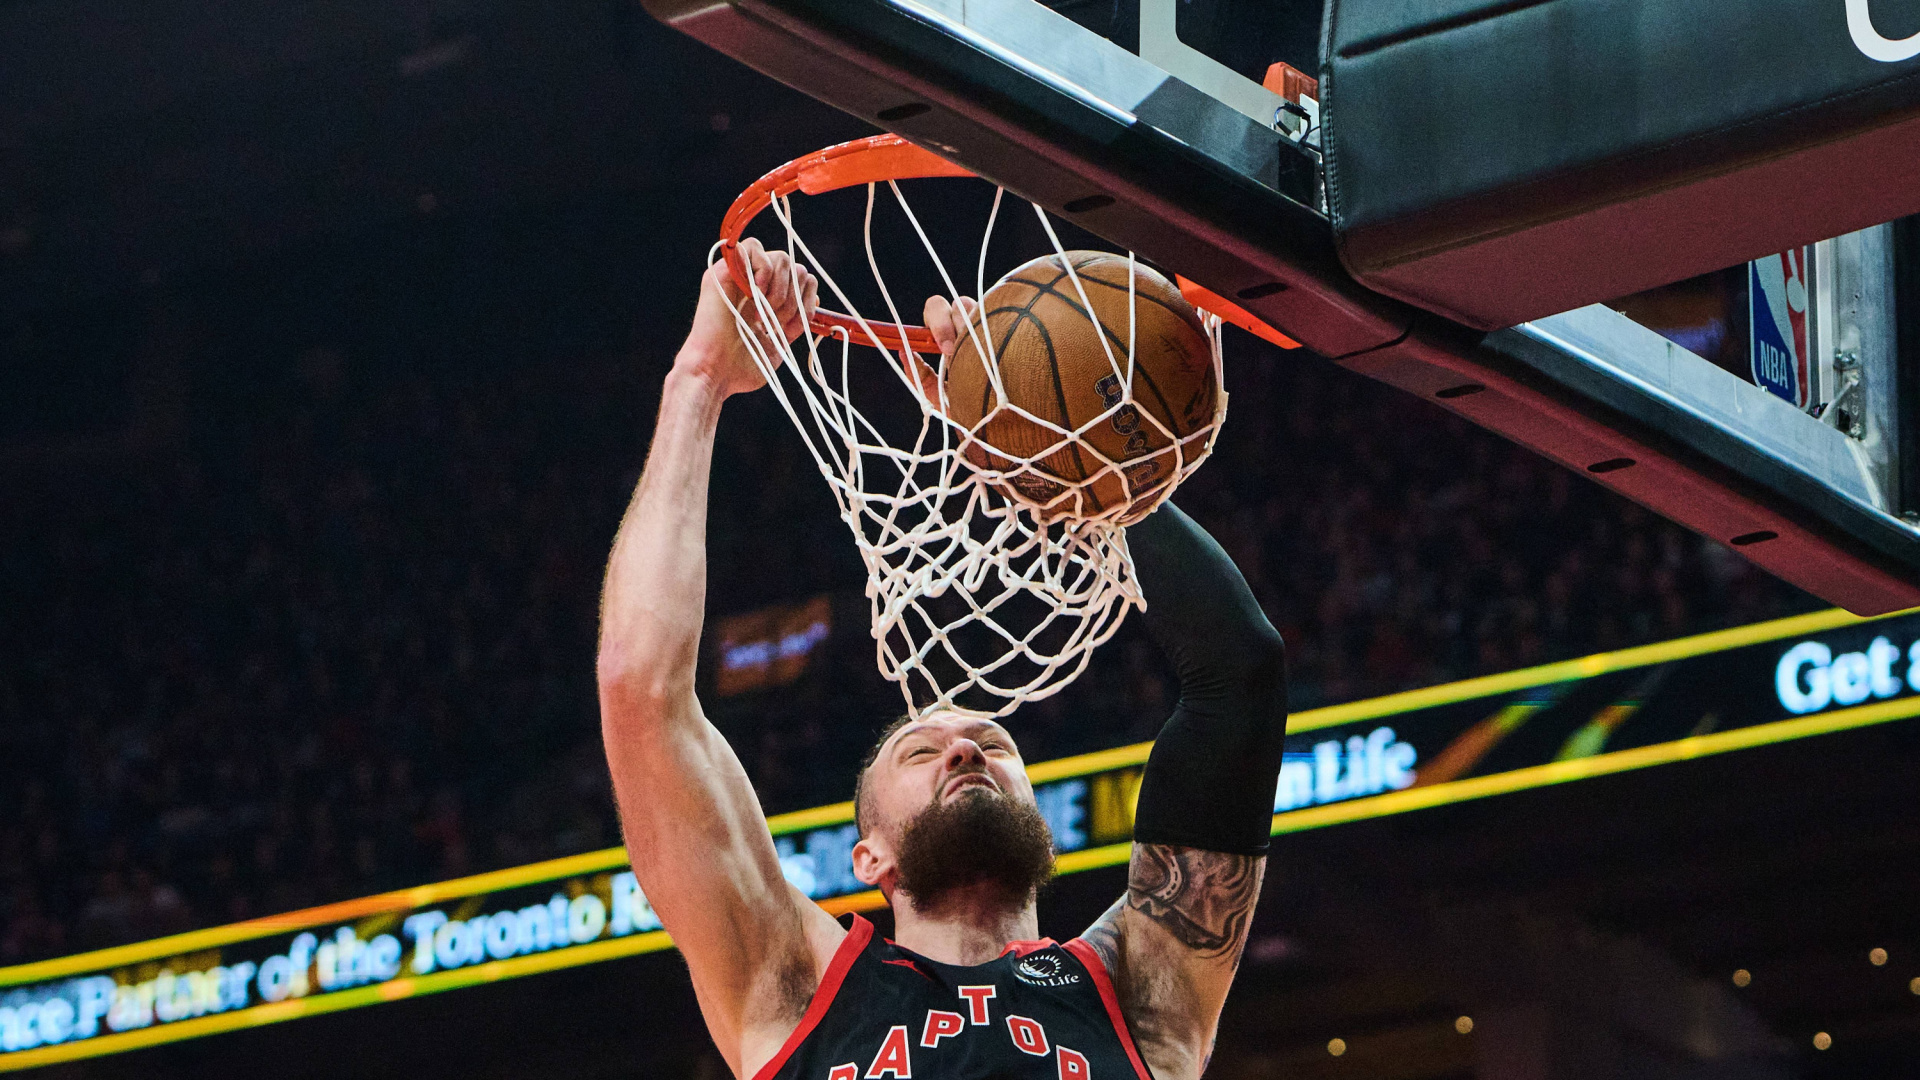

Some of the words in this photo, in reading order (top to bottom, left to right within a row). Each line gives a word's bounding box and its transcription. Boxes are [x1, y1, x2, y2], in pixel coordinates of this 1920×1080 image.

[1760, 340, 1789, 390] NBA
[1775, 635, 1903, 714] Get
[1312, 726, 1418, 804] Life
[76, 960, 257, 1038] Partner
[257, 932, 318, 1003] of
[317, 926, 402, 991] the
[403, 892, 606, 975] Toronto
[1048, 974, 1080, 987] Life
